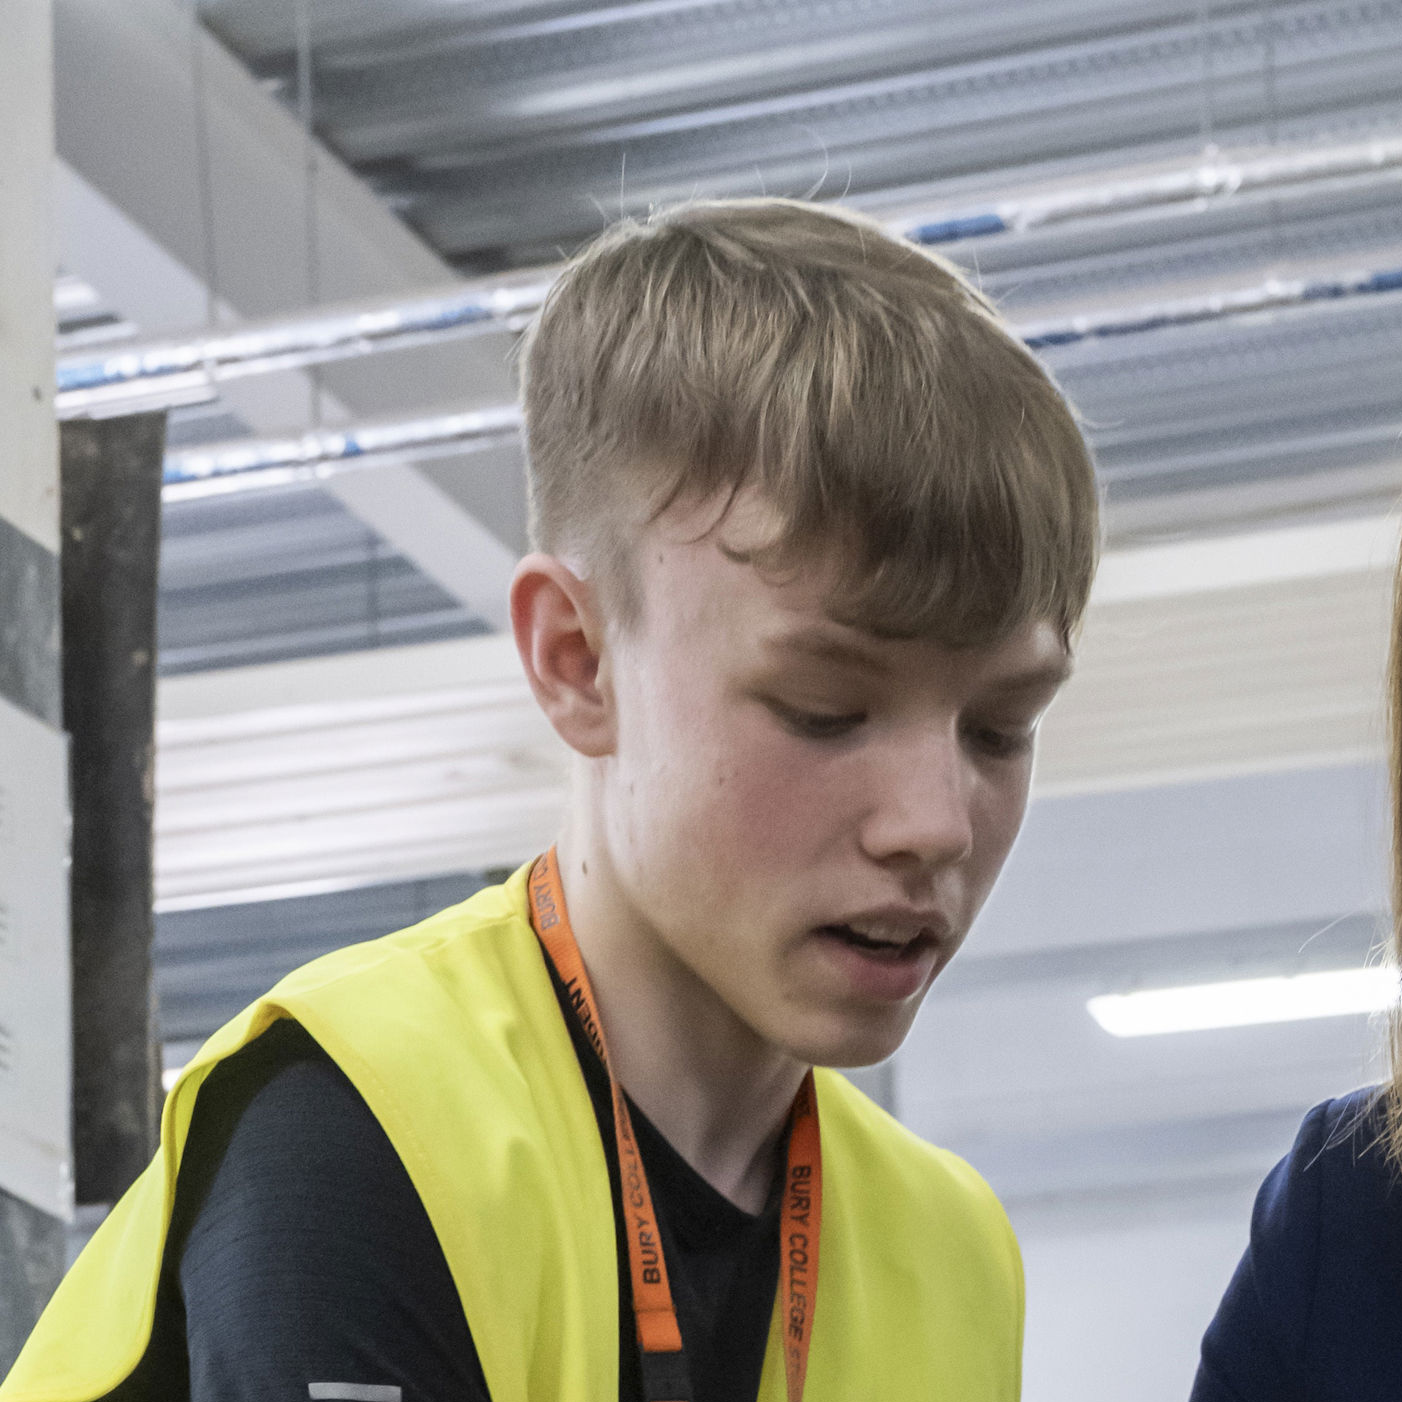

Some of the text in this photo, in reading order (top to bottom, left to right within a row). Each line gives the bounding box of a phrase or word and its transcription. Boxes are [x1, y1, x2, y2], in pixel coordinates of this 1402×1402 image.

[790, 1165, 811, 1227] BURY
[629, 1215, 661, 1285] BURY
[788, 1233, 808, 1342] COLLEGE
